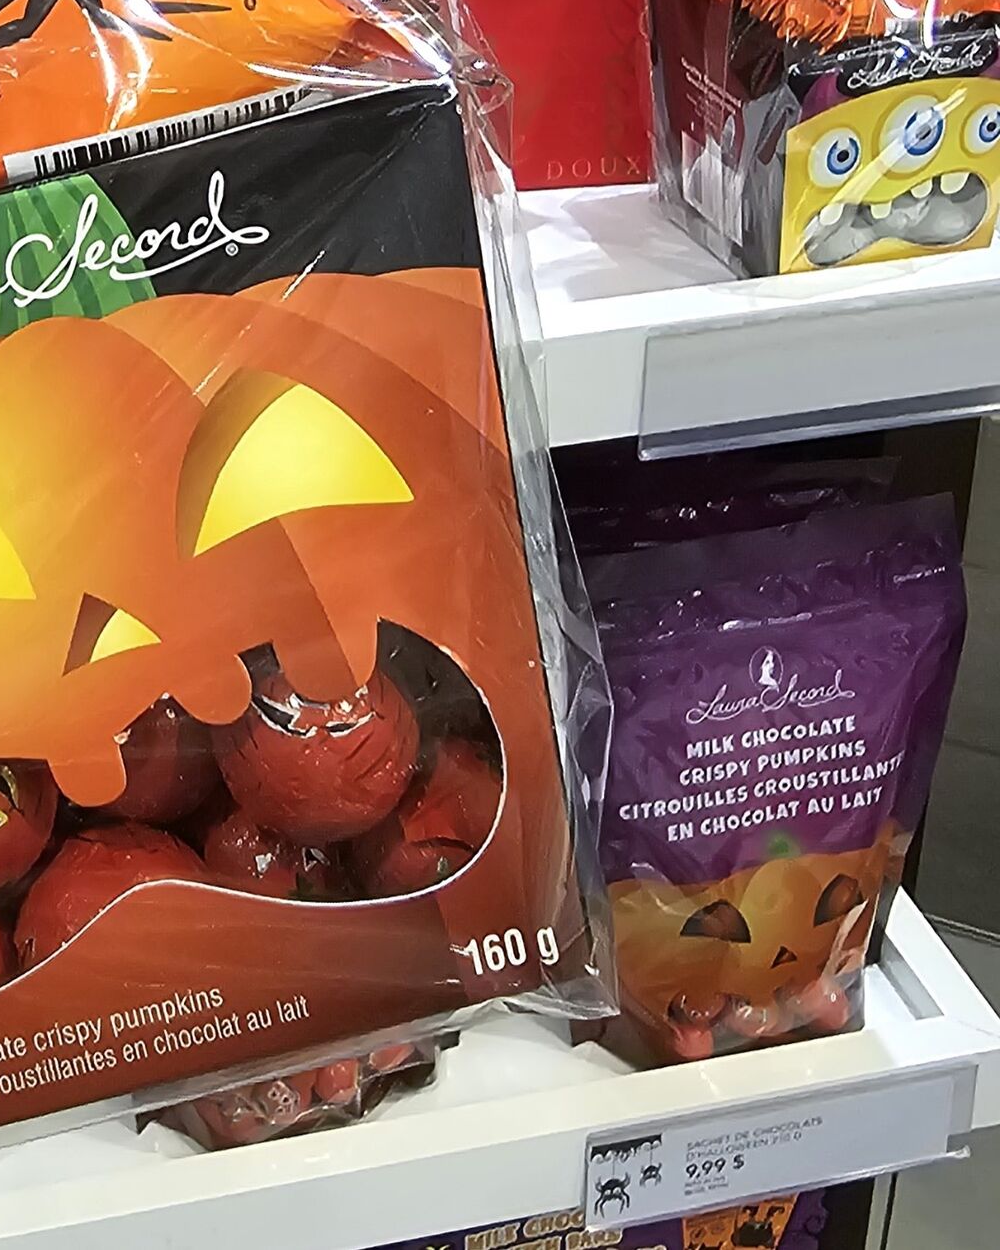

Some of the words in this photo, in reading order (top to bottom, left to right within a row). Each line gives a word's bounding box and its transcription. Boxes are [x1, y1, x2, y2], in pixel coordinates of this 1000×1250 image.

[546, 156, 642, 181] DOUX
[3, 169, 270, 309] Secord
[686, 684, 760, 725] Laura
[686, 734, 736, 760] MILK
[740, 714, 857, 749] CHOCOLATE
[678, 758, 752, 786] CRISPY
[756, 739, 867, 773] PUMPKINS
[618, 786, 750, 822] CITROUILLES
[666, 822, 694, 843] EN
[699, 799, 801, 837] CHOCOLAT
[806, 795, 835, 815] AU
[840, 786, 884, 811] LAIT
[463, 928, 528, 976] 160
[536, 926, 560, 966] g
[32, 1016, 103, 1053] crispy
[109, 984, 225, 1037] pumpkins
[121, 1039, 150, 1060] en
[153, 1012, 243, 1057] chocolat
[246, 1005, 273, 1033] au
[275, 994, 310, 1024] lait
[685, 1156, 727, 1179] 9,99
[733, 1153, 745, 1170] $
